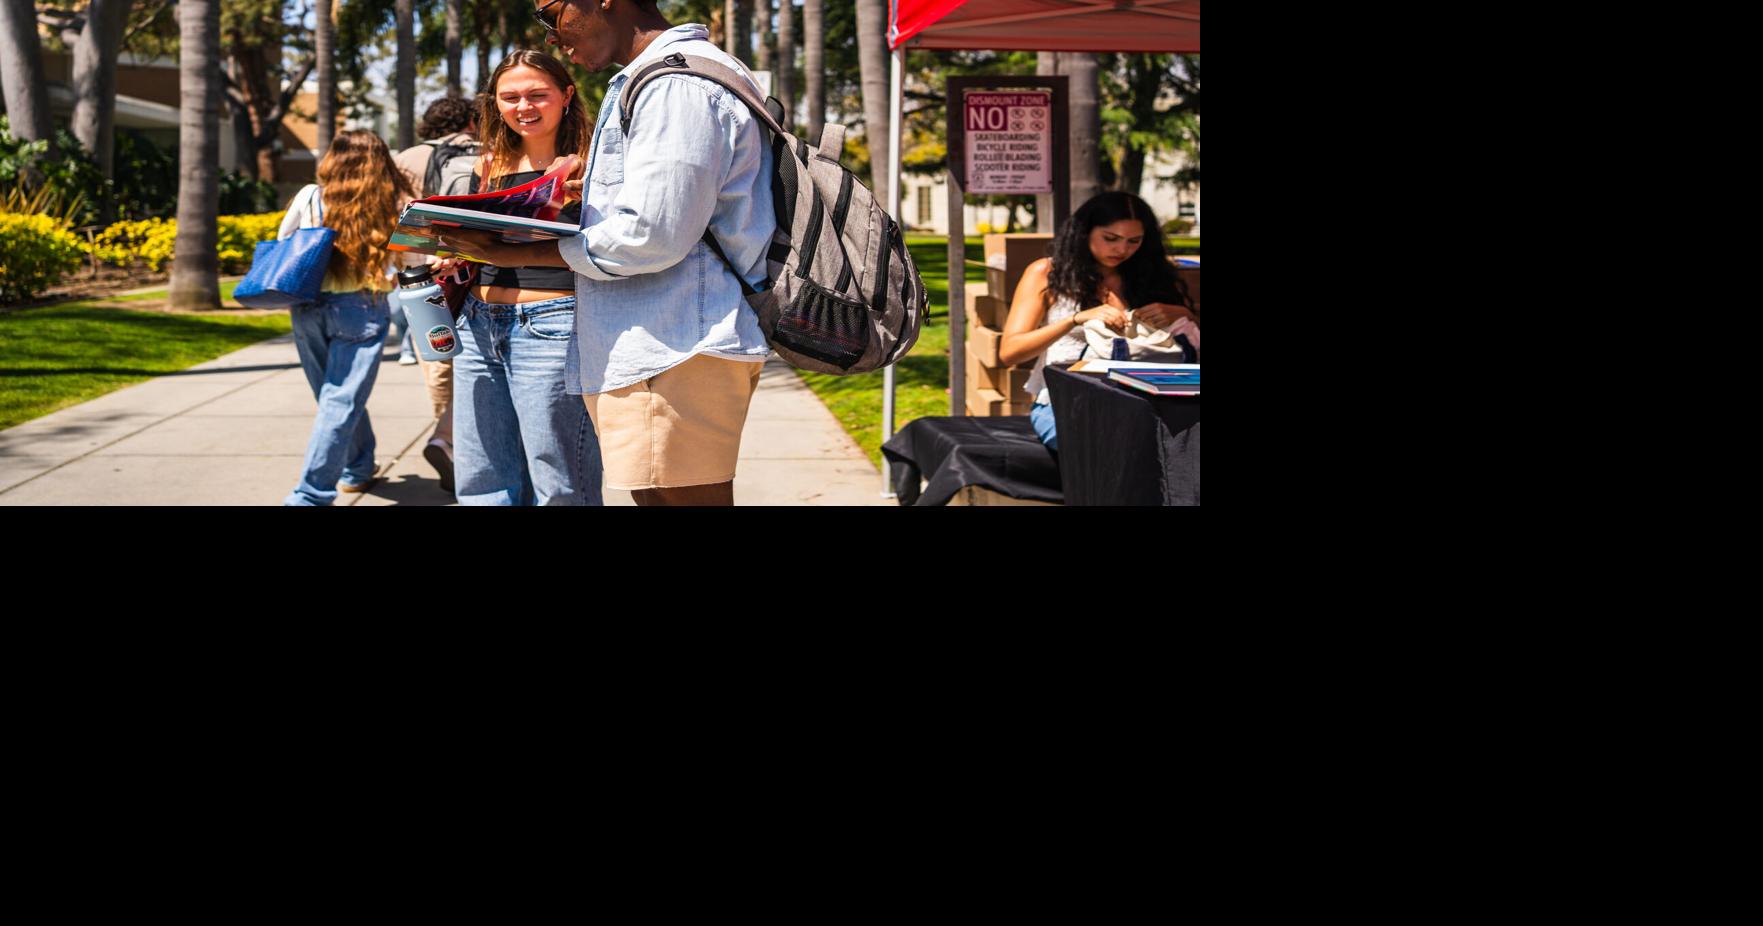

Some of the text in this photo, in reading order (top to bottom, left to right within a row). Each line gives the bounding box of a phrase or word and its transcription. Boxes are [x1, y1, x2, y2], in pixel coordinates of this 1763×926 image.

[968, 96, 1045, 105] DISMOUNT ZONE
[969, 107, 1005, 130] NO
[974, 133, 1041, 141] SKATEBOARDING
[976, 143, 1038, 151] BICYCLE RIDING
[1005, 153, 1042, 161] BLADING
[974, 163, 1041, 171] SCOOTER RIDING
